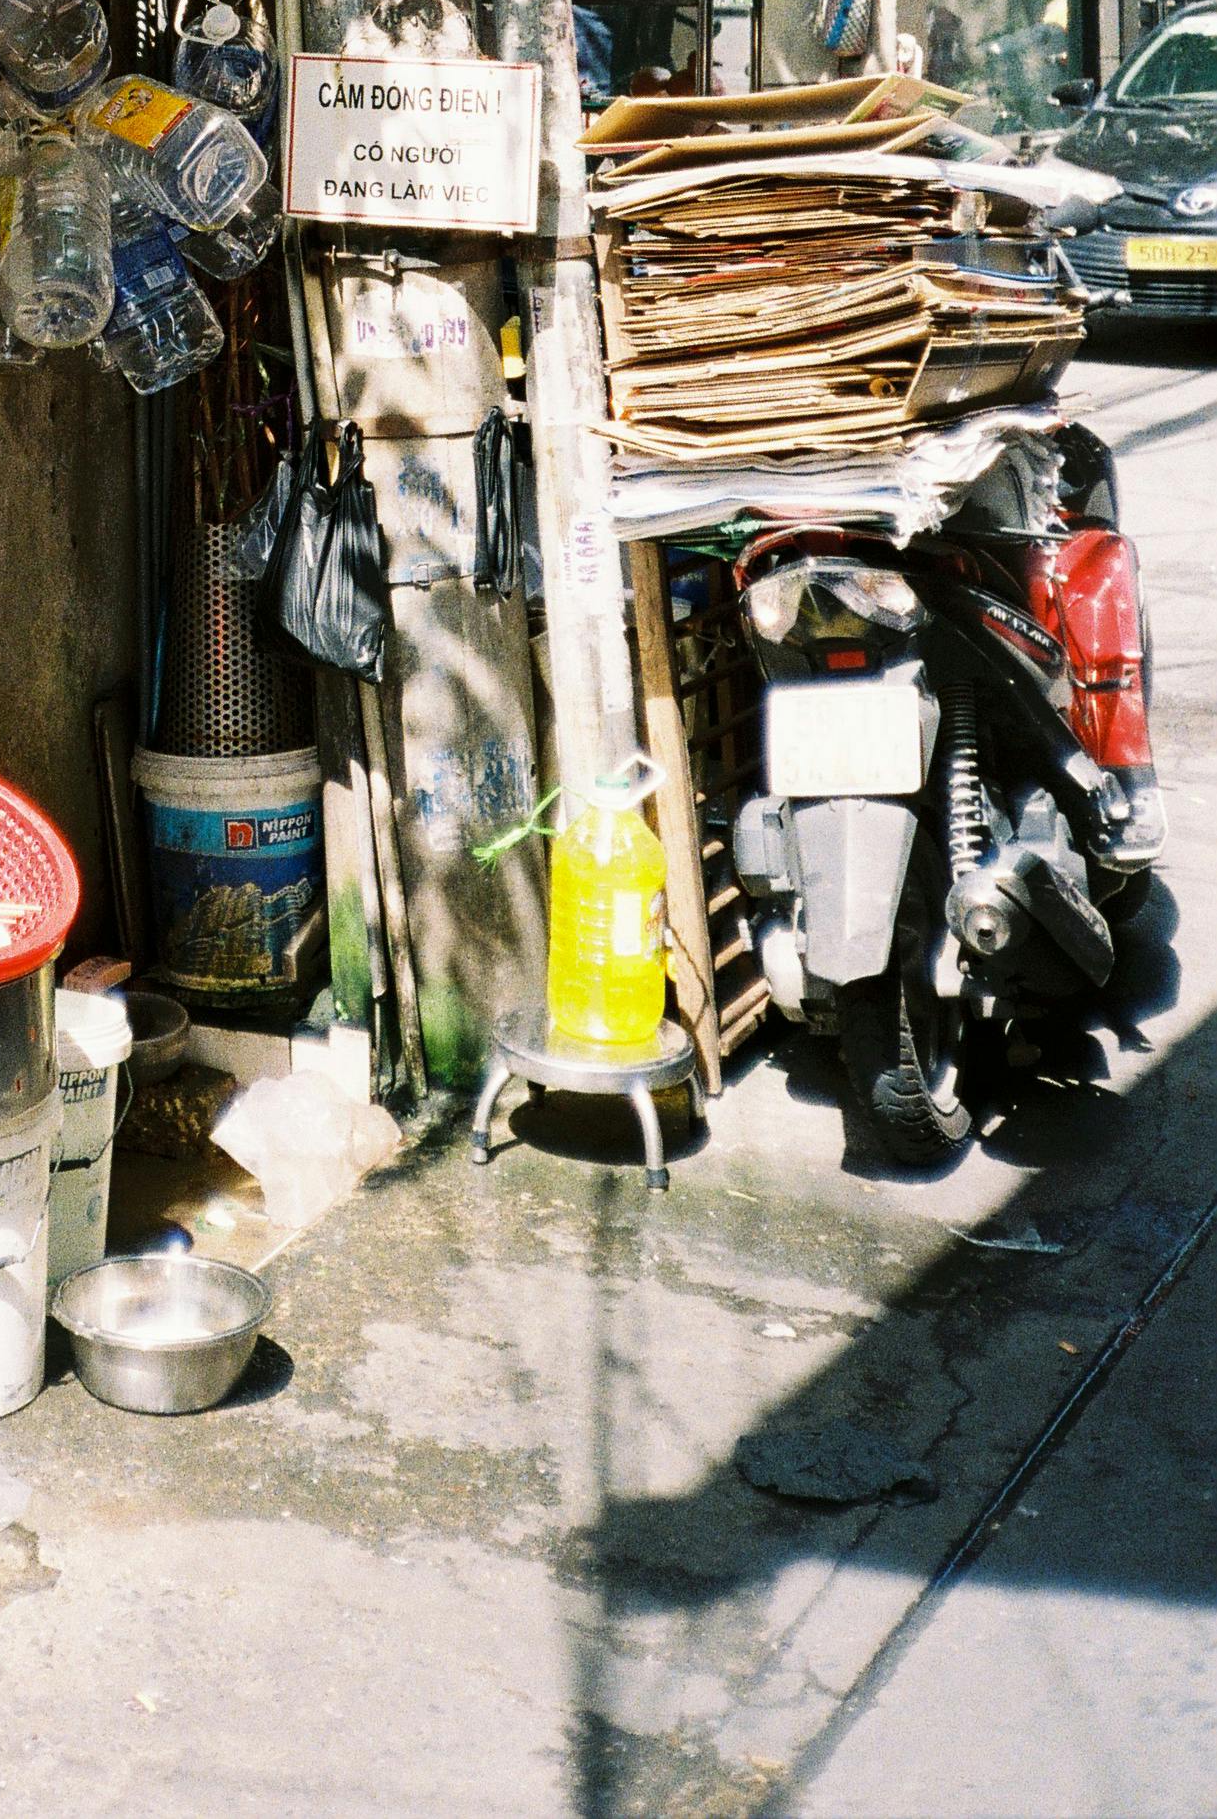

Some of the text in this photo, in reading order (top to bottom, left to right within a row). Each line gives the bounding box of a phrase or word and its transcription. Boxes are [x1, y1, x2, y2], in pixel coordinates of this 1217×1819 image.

[318, 76, 364, 110] CẤM
[370, 79, 433, 111] ĐÓNG
[353, 140, 384, 162] CÓ
[324, 179, 384, 198] ĐANG
[390, 179, 434, 200] LÀM
[262, 813, 312, 833] NIPPON
[268, 826, 308, 844] PAINT
[59, 1068, 107, 1088] IPPON
[64, 1083, 100, 1103] AINT
